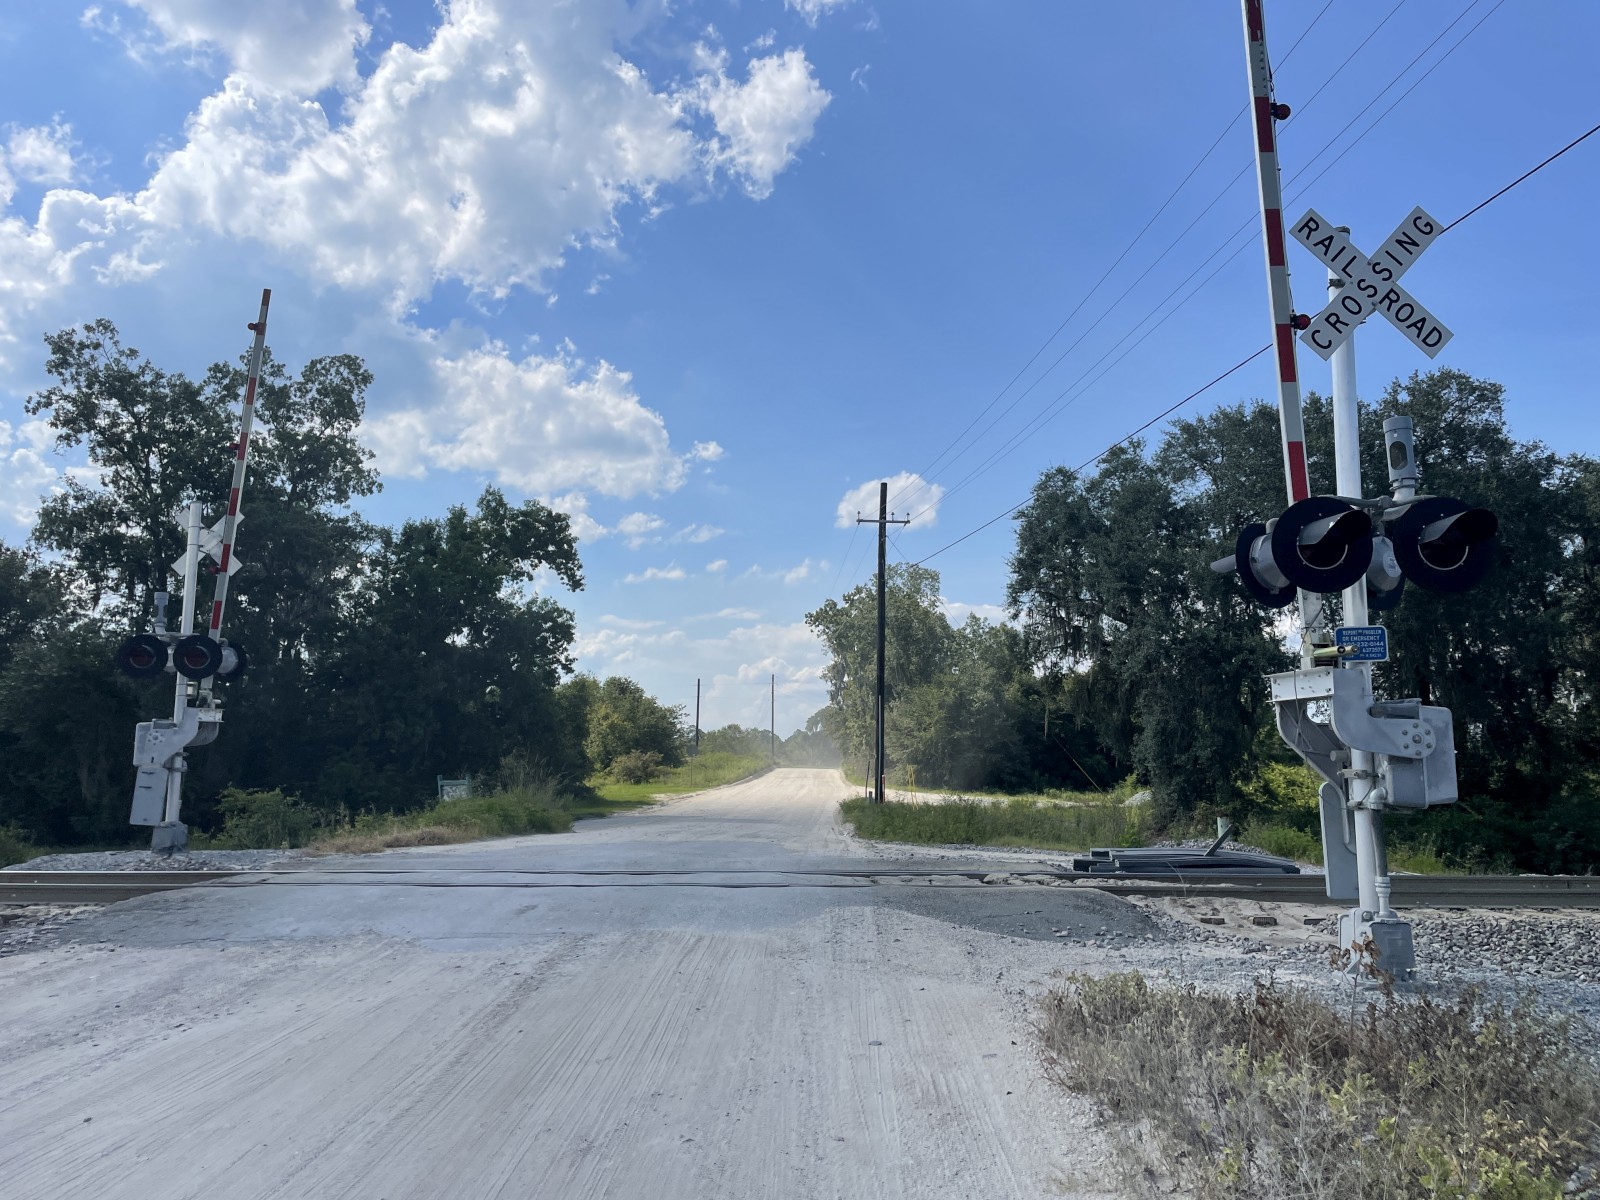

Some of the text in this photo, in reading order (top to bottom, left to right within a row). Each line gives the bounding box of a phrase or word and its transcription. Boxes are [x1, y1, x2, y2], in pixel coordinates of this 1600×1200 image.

[1297, 216, 1358, 279] RAIL
[1310, 215, 1434, 350] CROSSING
[1378, 287, 1443, 348] ROAD
